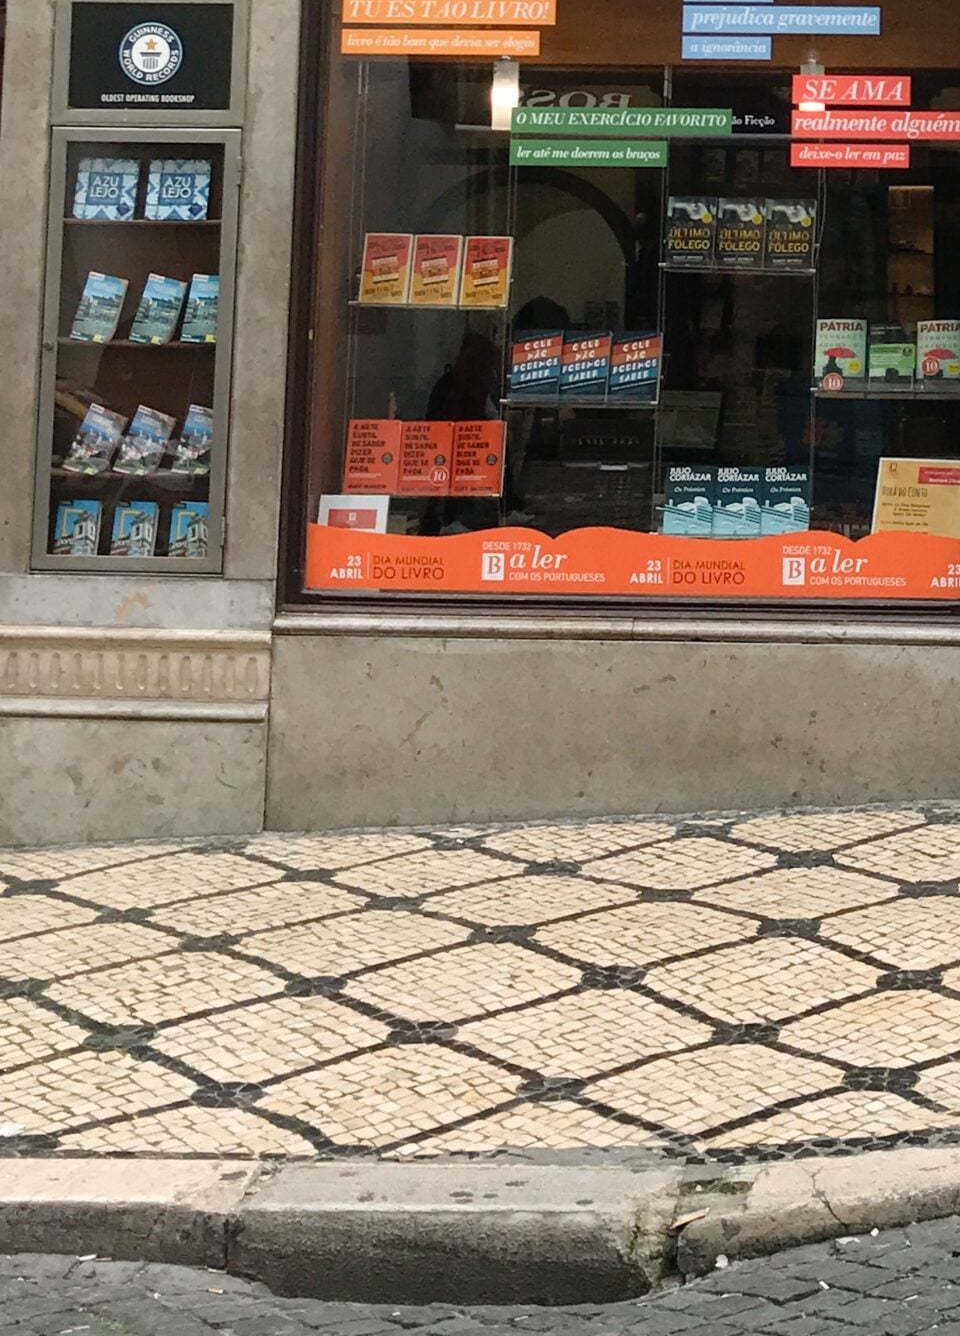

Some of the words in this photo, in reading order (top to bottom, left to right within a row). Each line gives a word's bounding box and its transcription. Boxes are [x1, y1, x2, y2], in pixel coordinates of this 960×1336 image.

[349, 0, 383, 18] TU
[471, 0, 550, 20] LIVRO!
[692, 8, 774, 30] prejudica
[777, 12, 877, 30] gravemente
[129, 26, 175, 44] GUINNESS
[347, 35, 373, 46] livro
[383, 35, 400, 46] tão
[403, 35, 426, 46] bom
[429, 38, 449, 49] que
[451, 35, 482, 47] devia
[484, 39, 500, 47] ser
[690, 43, 699, 53] a
[701, 40, 766, 55] ignorância
[123, 49, 144, 79] WORLD
[145, 49, 179, 81] RECORDS
[802, 80, 836, 100] SE
[839, 80, 904, 101] AMA
[101, 94, 124, 102] OLDEST
[125, 94, 160, 103] OPERATING
[161, 94, 195, 103] BOOKSHOP
[516, 112, 527, 124] O
[528, 112, 565, 125] MEU
[568, 111, 651, 125] EXERCÍCIO
[656, 114, 727, 127] FAVORITO
[744, 115, 775, 128] Ficção
[794, 113, 887, 132] realmente
[891, 113, 960, 139] alguém
[517, 148, 532, 158] ler
[533, 147, 551, 159] até
[552, 151, 568, 159] me
[570, 148, 610, 159] doerem
[612, 151, 624, 159] os
[626, 148, 661, 162] braços
[799, 147, 842, 160] deixe-o
[844, 148, 860, 160] ler
[862, 150, 880, 160] em
[883, 150, 906, 164] paz
[92, 176, 119, 185] AZU
[164, 176, 192, 186] AZU
[89, 187, 119, 199] LEJO
[162, 187, 192, 199] LEJO
[669, 227, 711, 239] ÚLTIMO
[720, 228, 760, 240] ÚLTIMO
[769, 230, 809, 241] ÚLTIMO
[668, 239, 710, 250] FÔLEGO
[719, 240, 760, 251] FÔLEGO
[768, 241, 809, 253] FÔLEGO
[819, 320, 864, 331] PÁTRIA
[669, 472, 711, 481] CORTÁZAR
[717, 473, 760, 482] CORTÁZAR
[765, 472, 807, 482] CORTÁZAR
[482, 541, 511, 550] DESDE
[513, 542, 532, 551] 1732
[782, 546, 811, 555] DESDE
[813, 546, 831, 555] 1732
[347, 555, 361, 566] 23
[373, 555, 391, 565] DIA
[395, 556, 444, 566] MUNDIAL
[510, 553, 526, 569] a
[531, 545, 568, 569] ler
[810, 557, 827, 573] a
[832, 549, 868, 573] ler
[647, 560, 661, 571] 23
[673, 560, 691, 570] DIA
[695, 560, 745, 570] MUNDIAL
[330, 568, 363, 579] ABRIL
[373, 566, 396, 579] DO
[401, 567, 445, 580] LIVRO
[509, 572, 528, 581] COM
[530, 572, 542, 581] OS
[543, 572, 606, 582] PORTUGUESES
[630, 572, 663, 584] ABRIL
[673, 571, 696, 584] DO
[701, 572, 745, 584] LIVRO
[810, 577, 830, 585] COM
[831, 577, 842, 585] OS
[844, 577, 907, 587] PORTUGUESES
